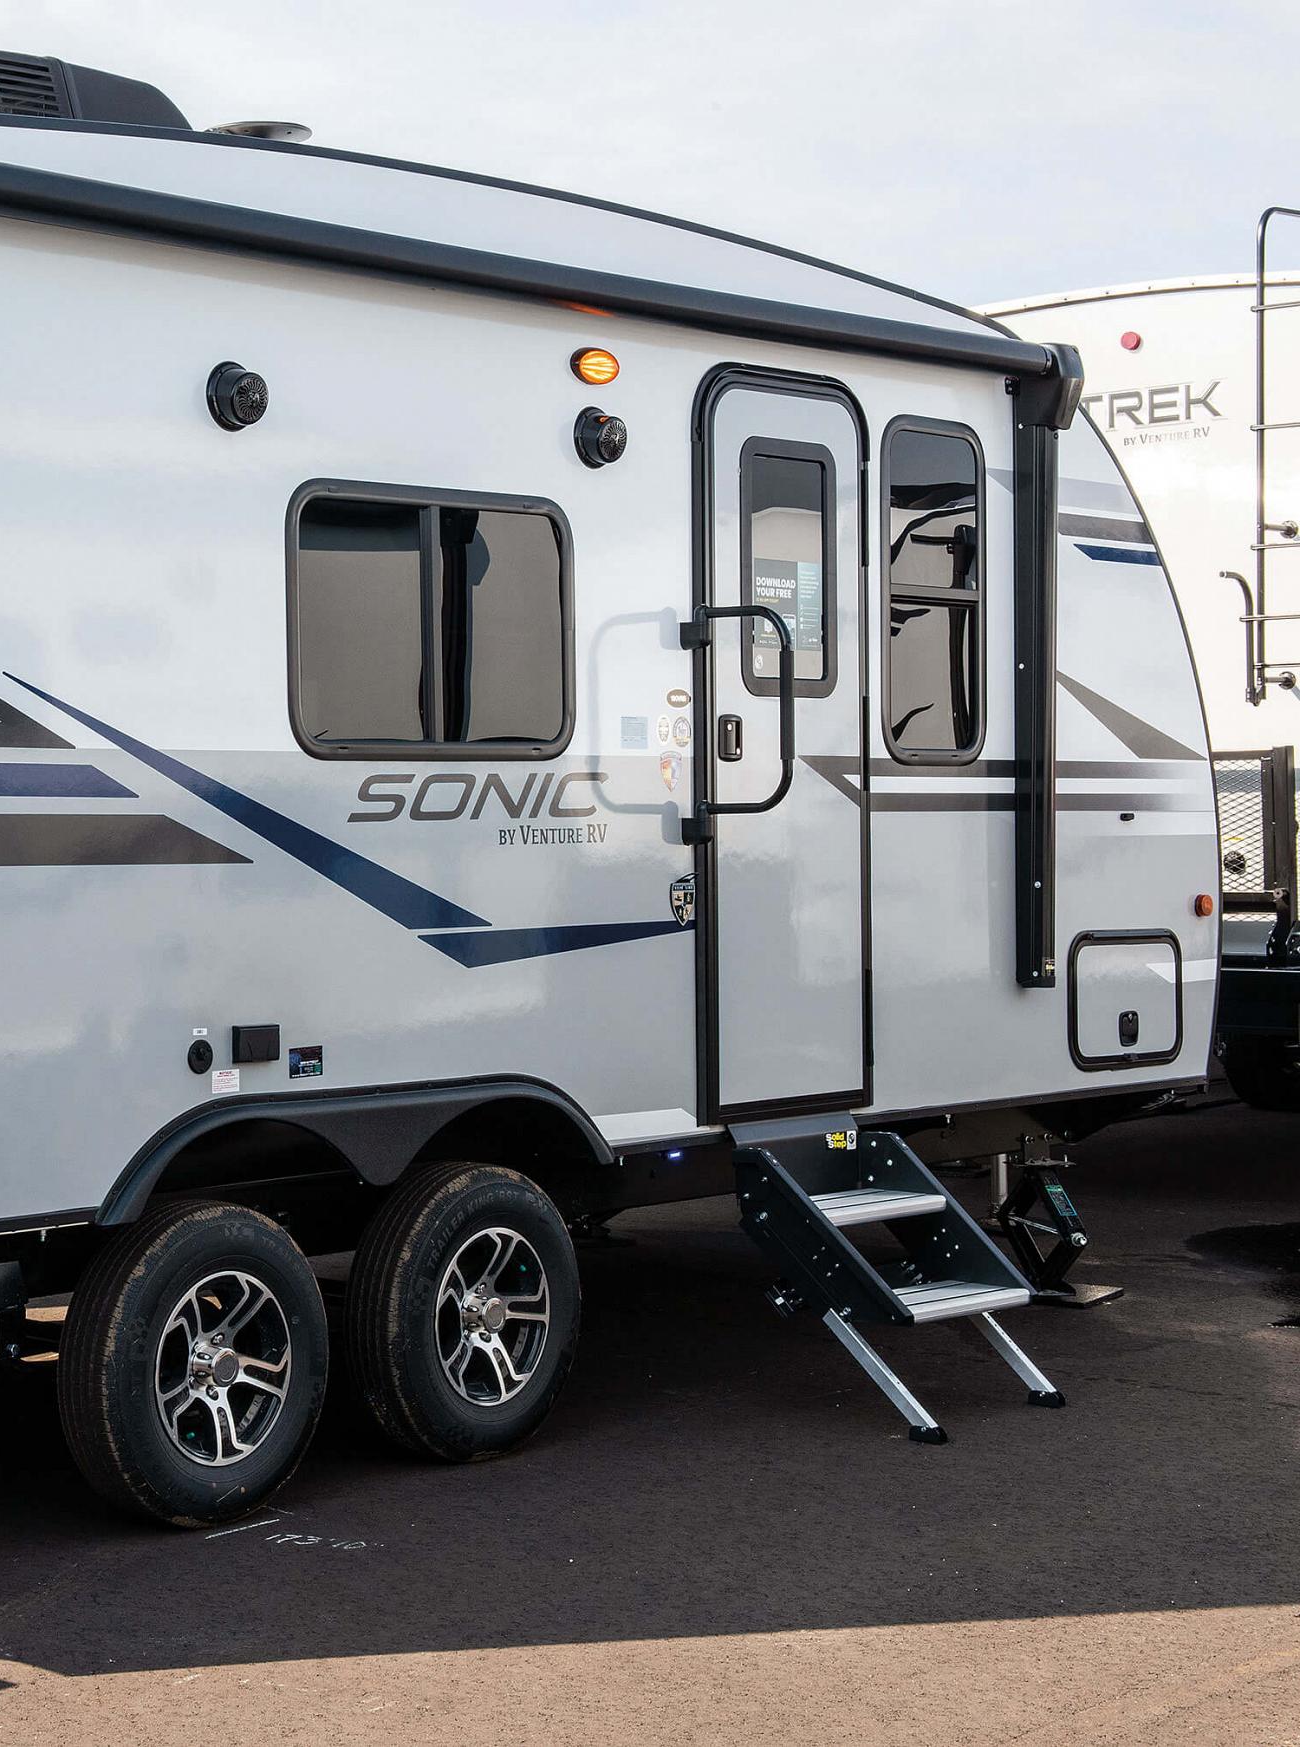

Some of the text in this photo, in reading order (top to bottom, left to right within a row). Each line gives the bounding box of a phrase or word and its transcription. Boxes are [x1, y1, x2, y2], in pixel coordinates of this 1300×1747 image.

[1079, 381, 1221, 429] TREK
[1193, 426, 1210, 438] RV
[756, 576, 796, 589] DOWNLOAD
[756, 587, 792, 599] YOUR FREE
[347, 772, 609, 823] SONIC
[587, 823, 608, 844] RV
[825, 1132, 845, 1142] Solid
[827, 1140, 847, 1150] Step
